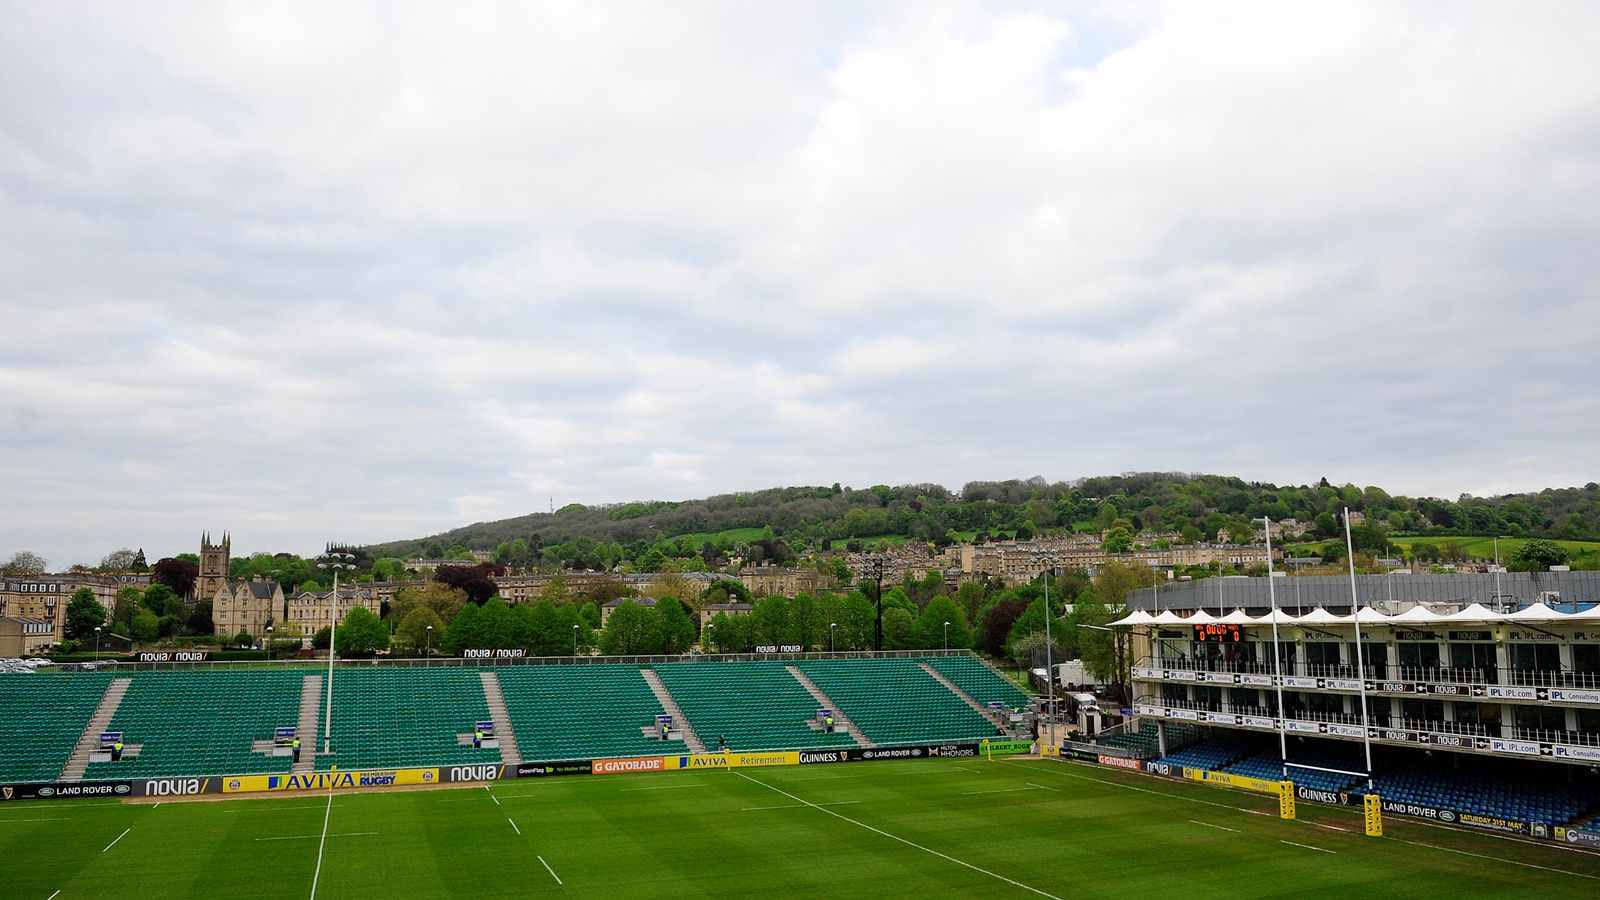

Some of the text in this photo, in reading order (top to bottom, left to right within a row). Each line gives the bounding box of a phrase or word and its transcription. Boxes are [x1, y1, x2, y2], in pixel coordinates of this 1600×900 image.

[1327, 680, 1337, 688] IPL
[1490, 688, 1533, 698] IPL IPL.com
[1551, 691, 1599, 702] IPL Consulting
[1329, 726, 1339, 734] IPL
[1493, 741, 1536, 753] IPL IPL.com
[1556, 747, 1570, 756] IPL
[799, 752, 838, 763] GUINNESS
[874, 749, 911, 758] LAND ROVER
[604, 759, 661, 771] GATORADE
[693, 756, 786, 767] AVIVA Retirement
[286, 773, 354, 790] AVIVA
[359, 776, 397, 785] RUGBY
[1211, 773, 1232, 783] AVIVA
[56, 785, 113, 795] LAND ROVER
[1298, 786, 1337, 804] GUINNESS
[1383, 801, 1437, 818] LAND ROVER
[1459, 813, 1492, 825] SATURDAY
